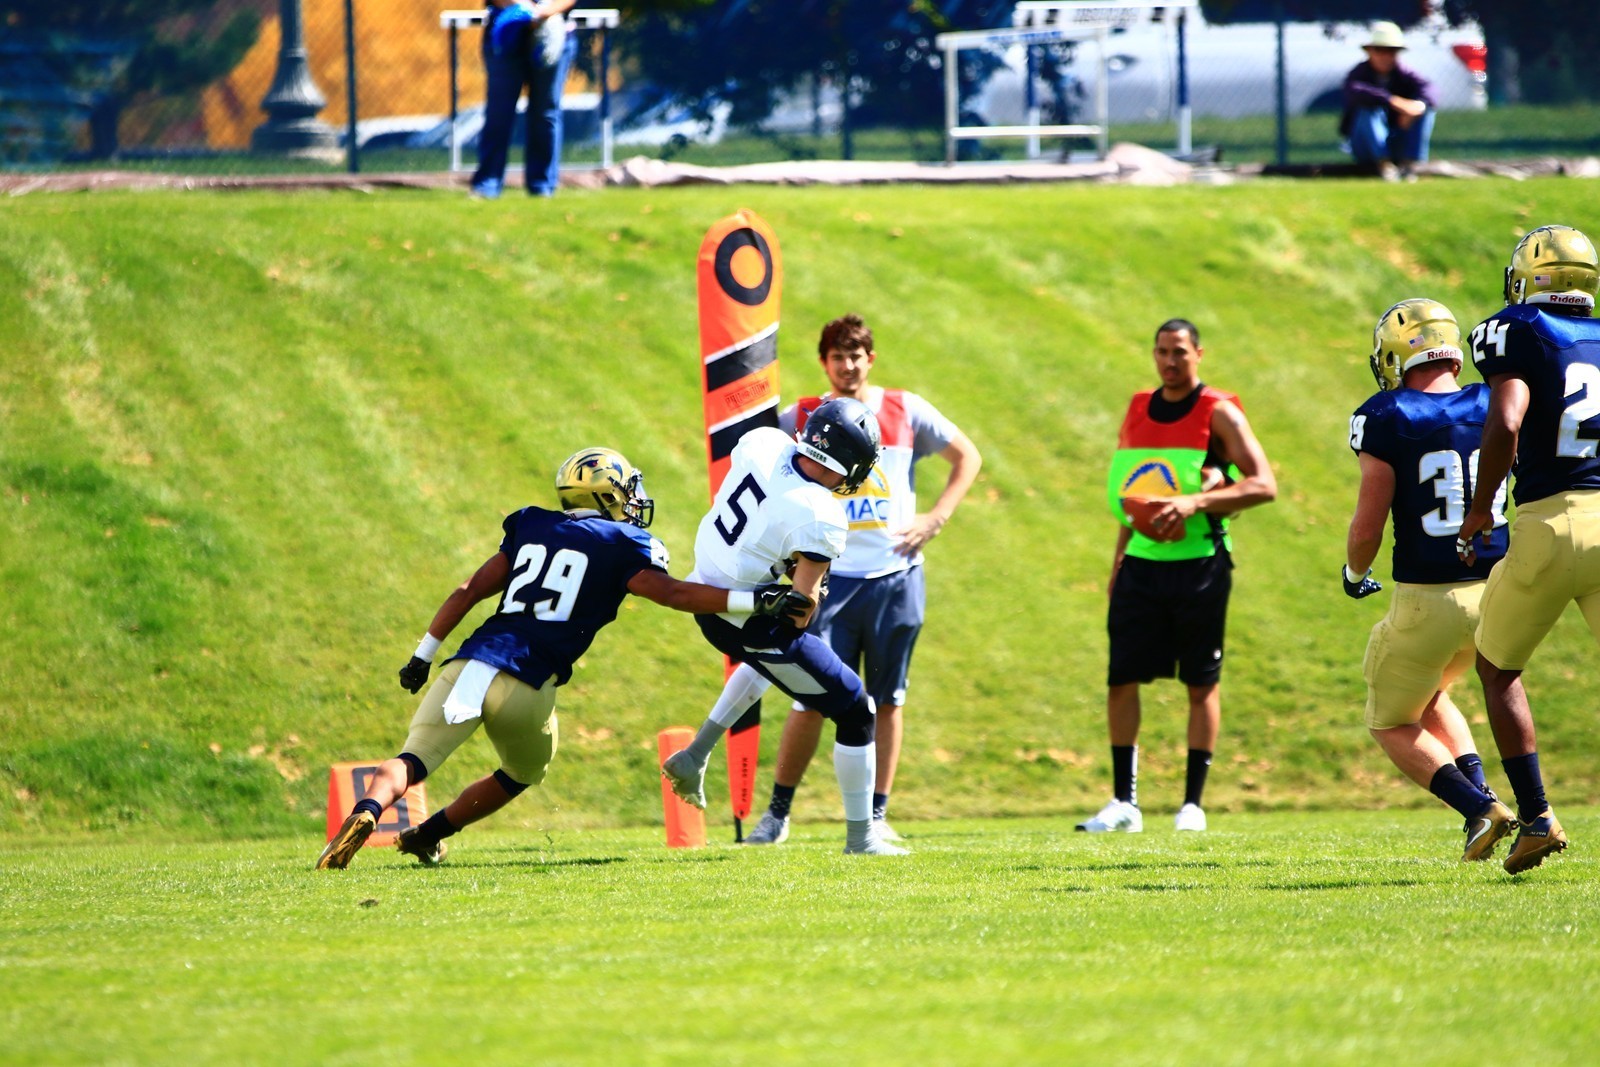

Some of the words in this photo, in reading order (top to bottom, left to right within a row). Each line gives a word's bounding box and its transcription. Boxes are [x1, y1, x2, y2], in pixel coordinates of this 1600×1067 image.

[1550, 294, 1587, 304] Riddell
[1427, 350, 1457, 360] Riddel
[1471, 319, 1511, 363] 24
[714, 472, 767, 546] 5
[500, 543, 589, 622] 29
